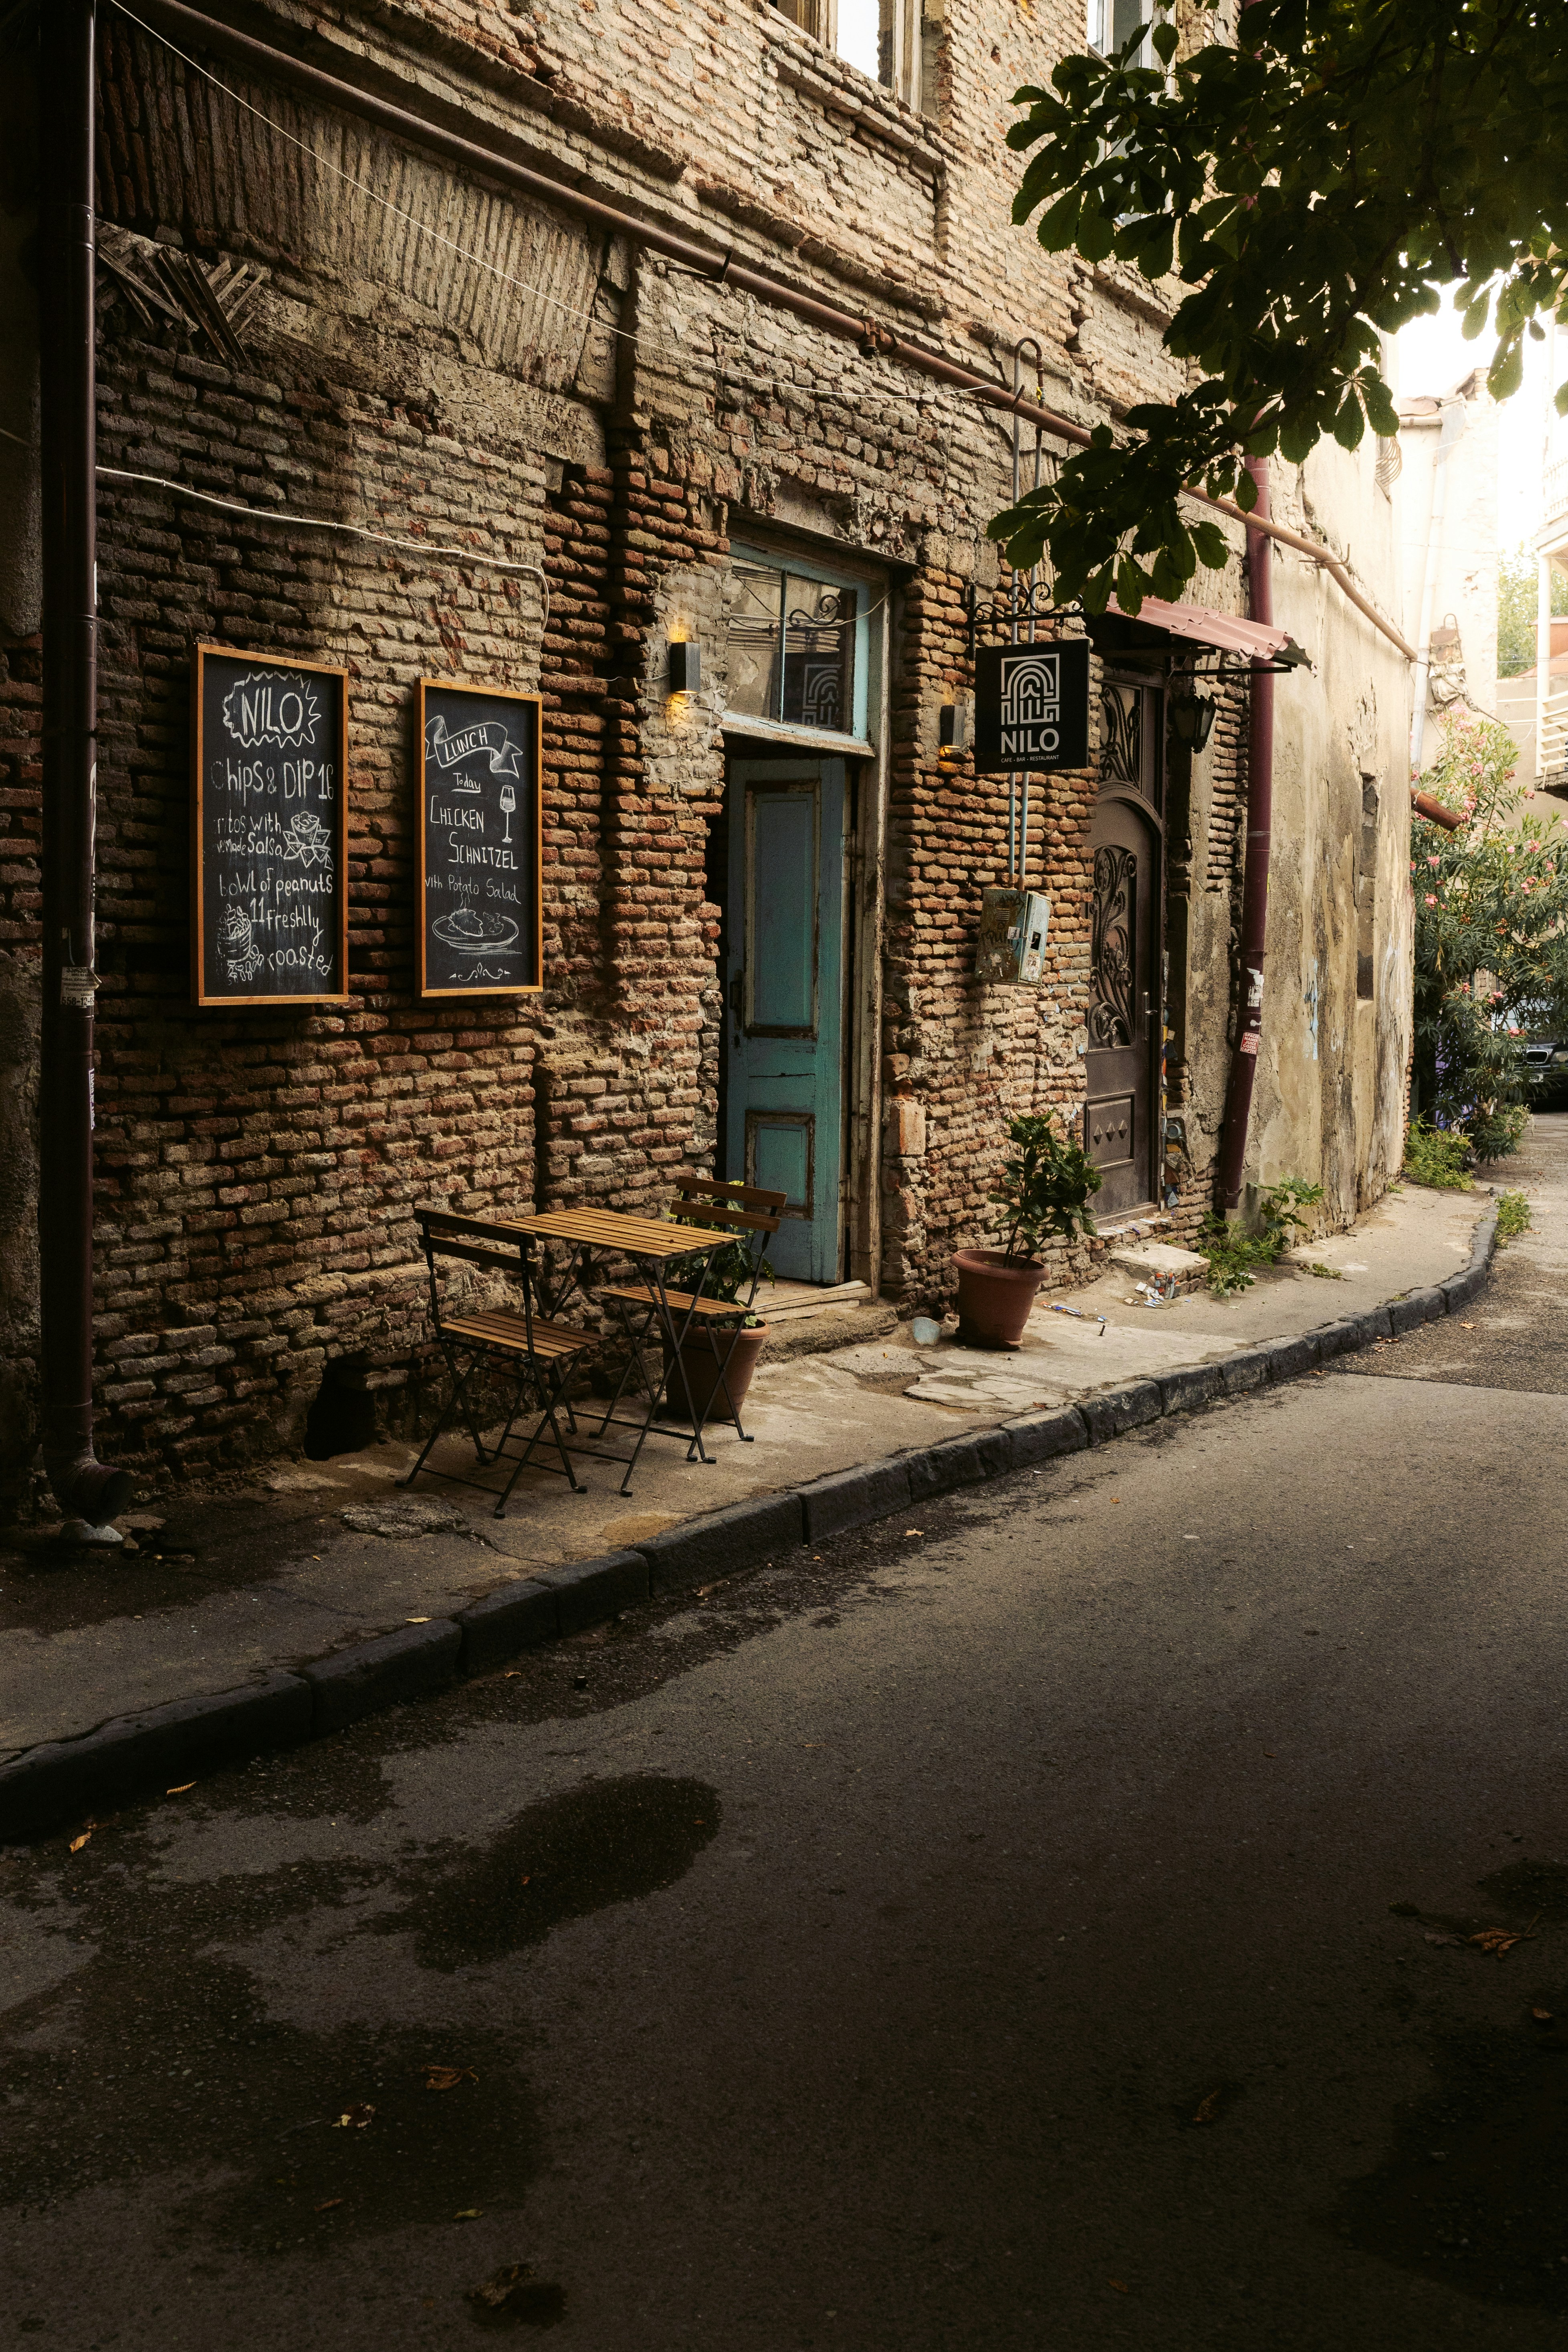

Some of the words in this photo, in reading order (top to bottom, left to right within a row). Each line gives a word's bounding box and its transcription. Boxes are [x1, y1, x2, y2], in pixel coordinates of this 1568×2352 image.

[242, 687, 303, 736] NILO
[444, 726, 488, 761] LUNCH
[1001, 728, 1059, 754] NILO
[266, 766, 277, 794] &
[453, 772, 481, 792] Today
[430, 795, 484, 833] CHICKEN
[248, 832, 283, 857] Salsa
[448, 831, 519, 869] SCHNITZEL
[260, 868, 274, 892] of
[448, 874, 479, 895] Potato
[486, 878, 522, 905] Salad
[250, 897, 264, 922] 11
[267, 946, 333, 976] roasted
